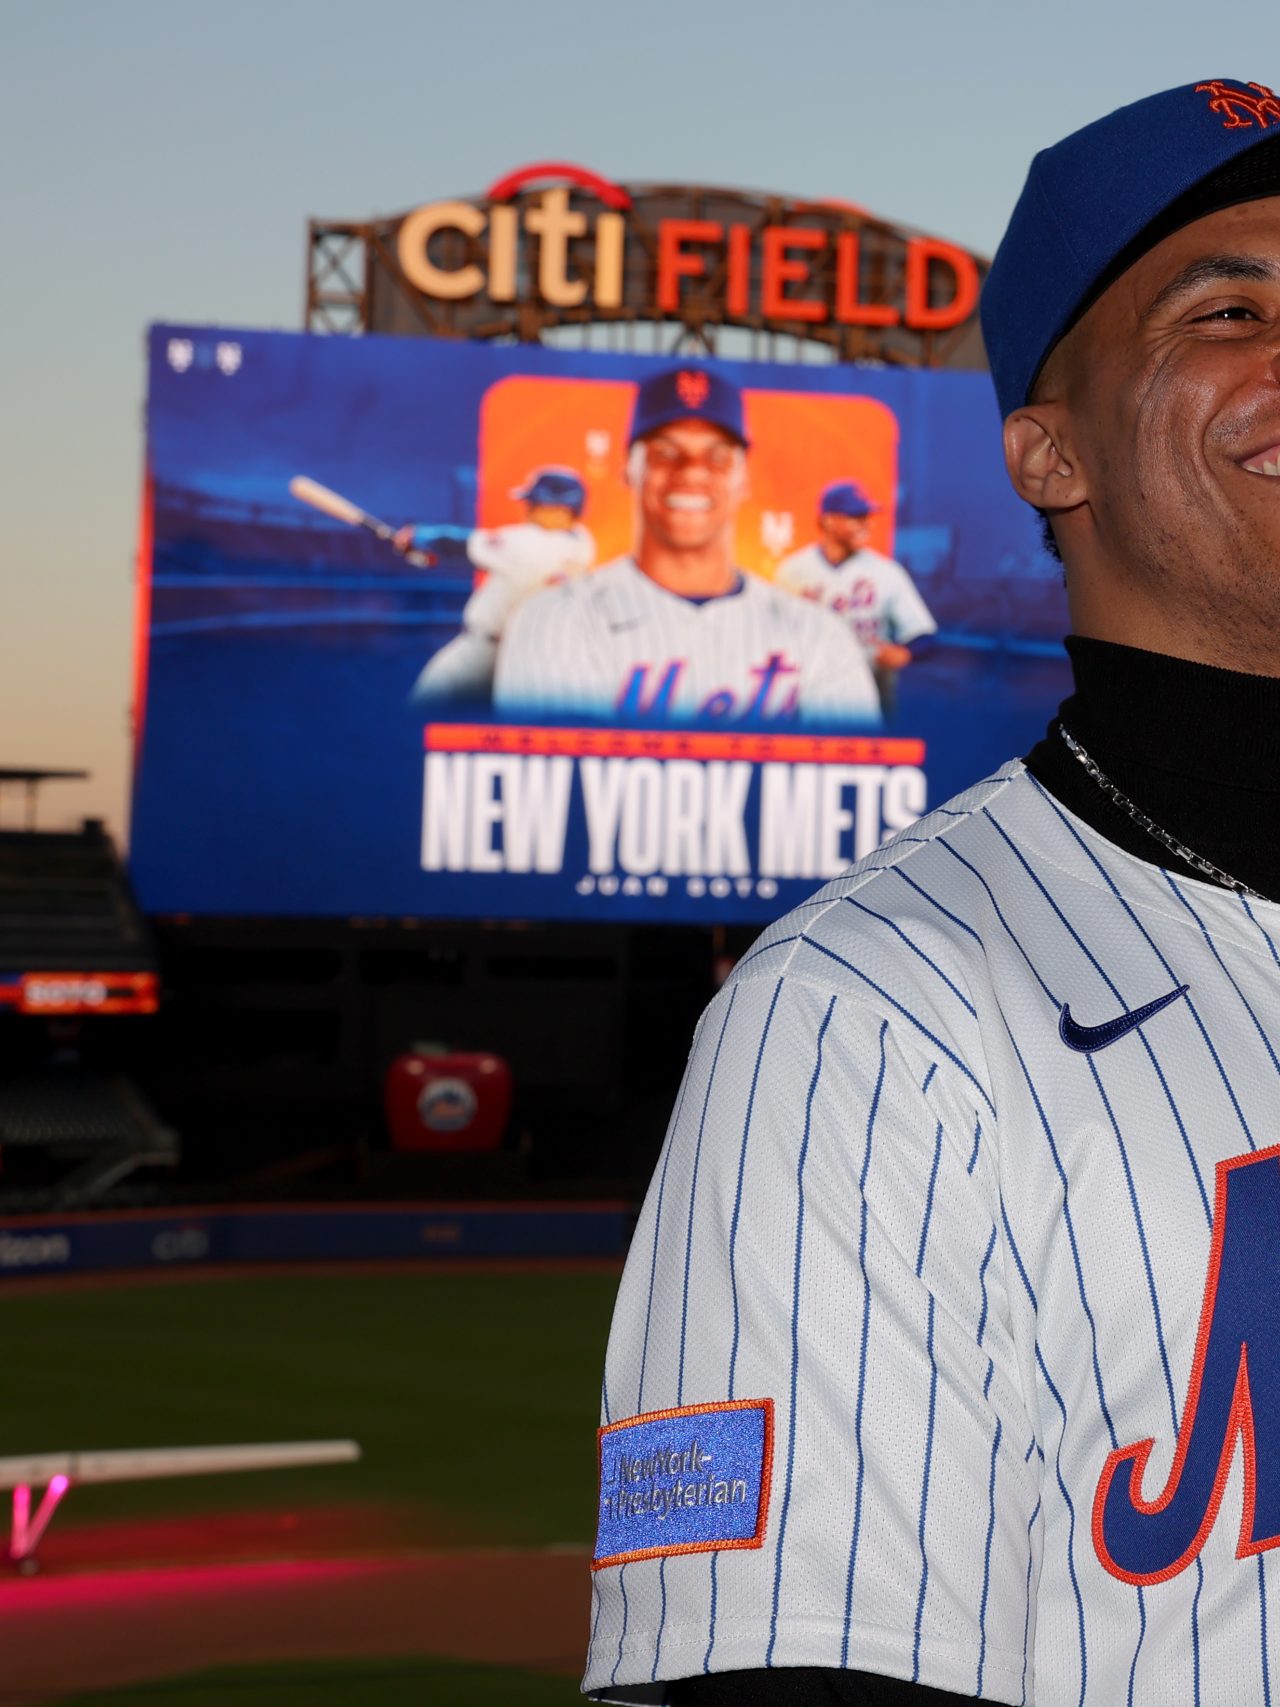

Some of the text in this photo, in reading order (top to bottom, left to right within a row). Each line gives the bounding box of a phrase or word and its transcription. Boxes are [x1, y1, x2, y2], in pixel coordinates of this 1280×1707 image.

[399, 188, 980, 330] citi FIELD
[422, 753, 928, 882] NEW YORK METS
